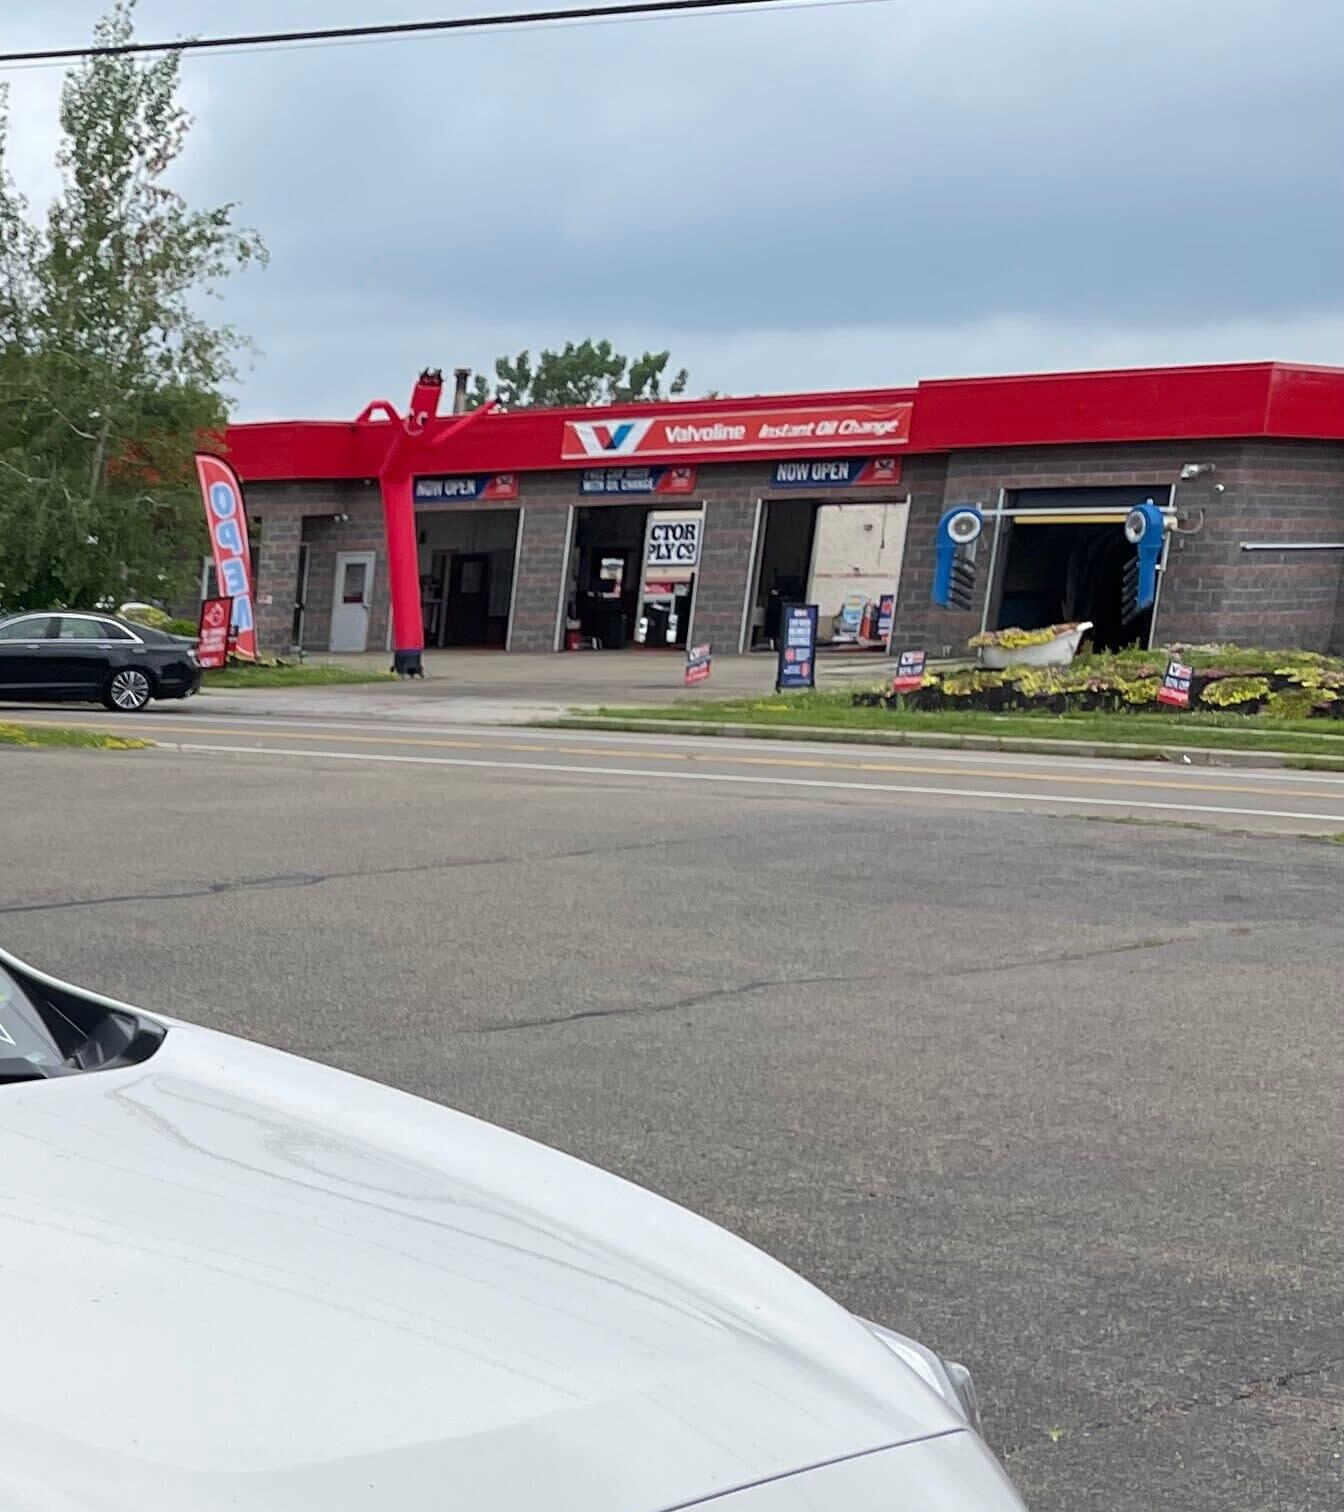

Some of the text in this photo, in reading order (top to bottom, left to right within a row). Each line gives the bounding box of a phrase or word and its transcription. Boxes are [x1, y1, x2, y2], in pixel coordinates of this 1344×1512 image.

[664, 417, 899, 444] Valvoline Instant Oil Change
[776, 462, 810, 482] NOW
[811, 460, 849, 481] OPEN
[415, 479, 443, 497] NOW
[444, 479, 476, 496] OPEN
